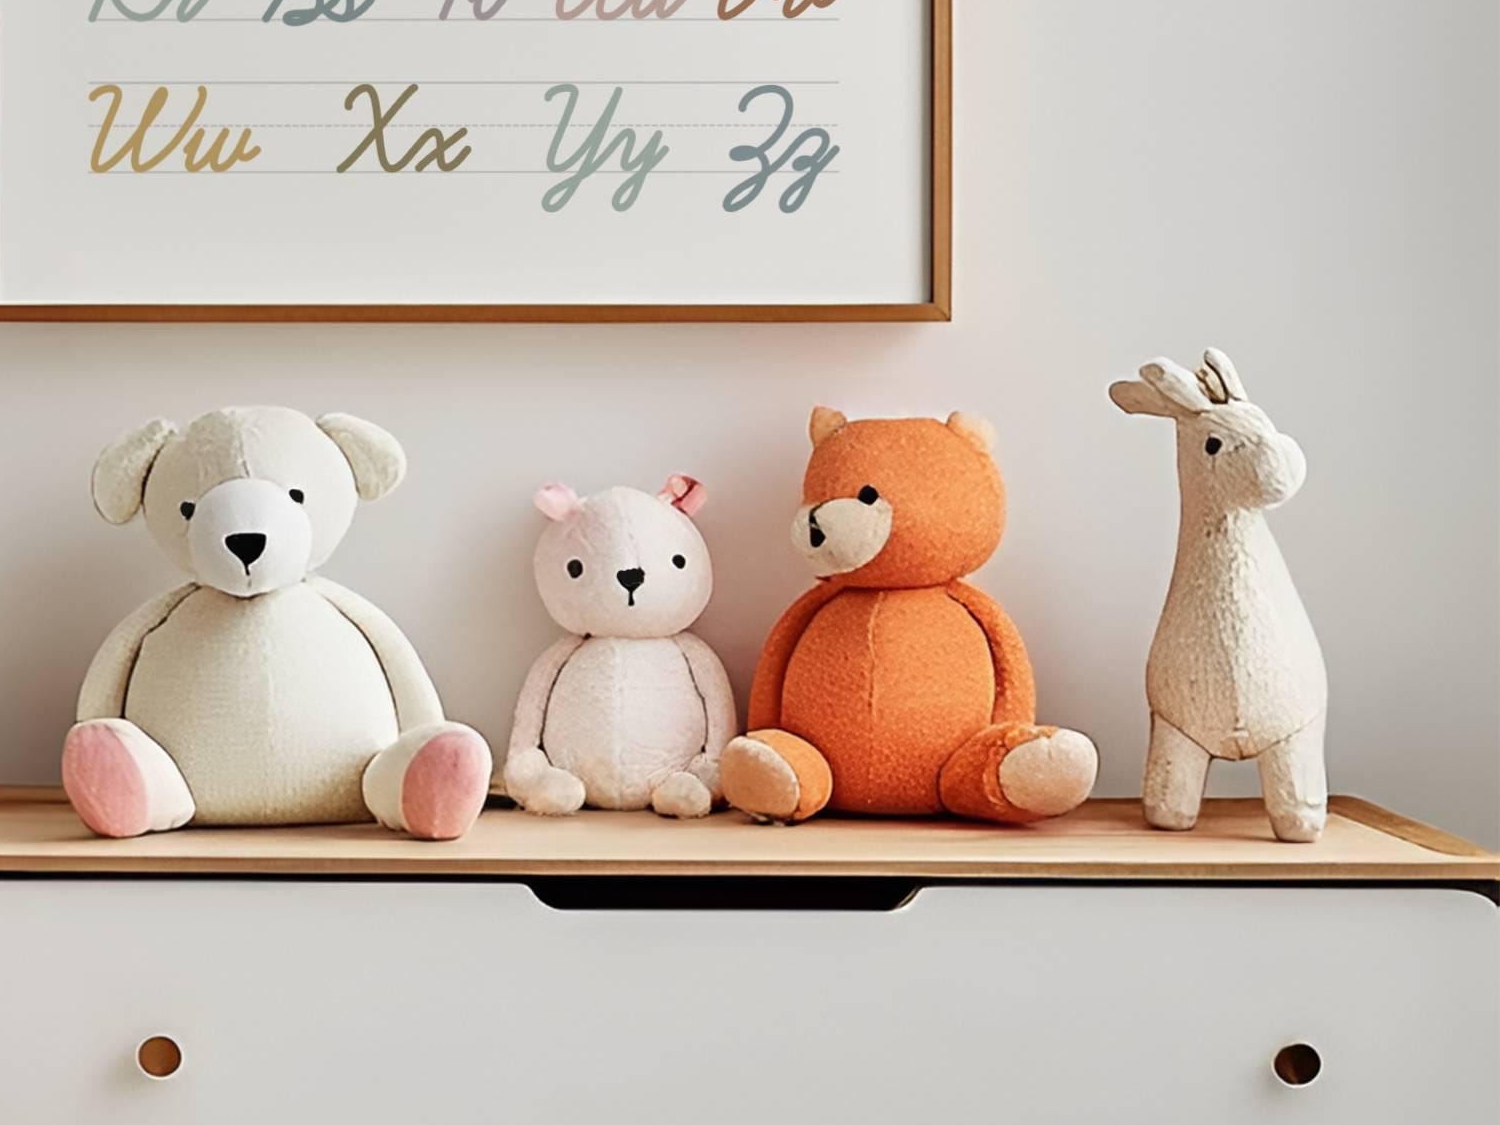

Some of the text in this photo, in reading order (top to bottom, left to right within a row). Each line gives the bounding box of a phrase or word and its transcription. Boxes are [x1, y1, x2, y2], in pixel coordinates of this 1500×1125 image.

[88, 83, 840, 214] Ww Xx Yy Zz
